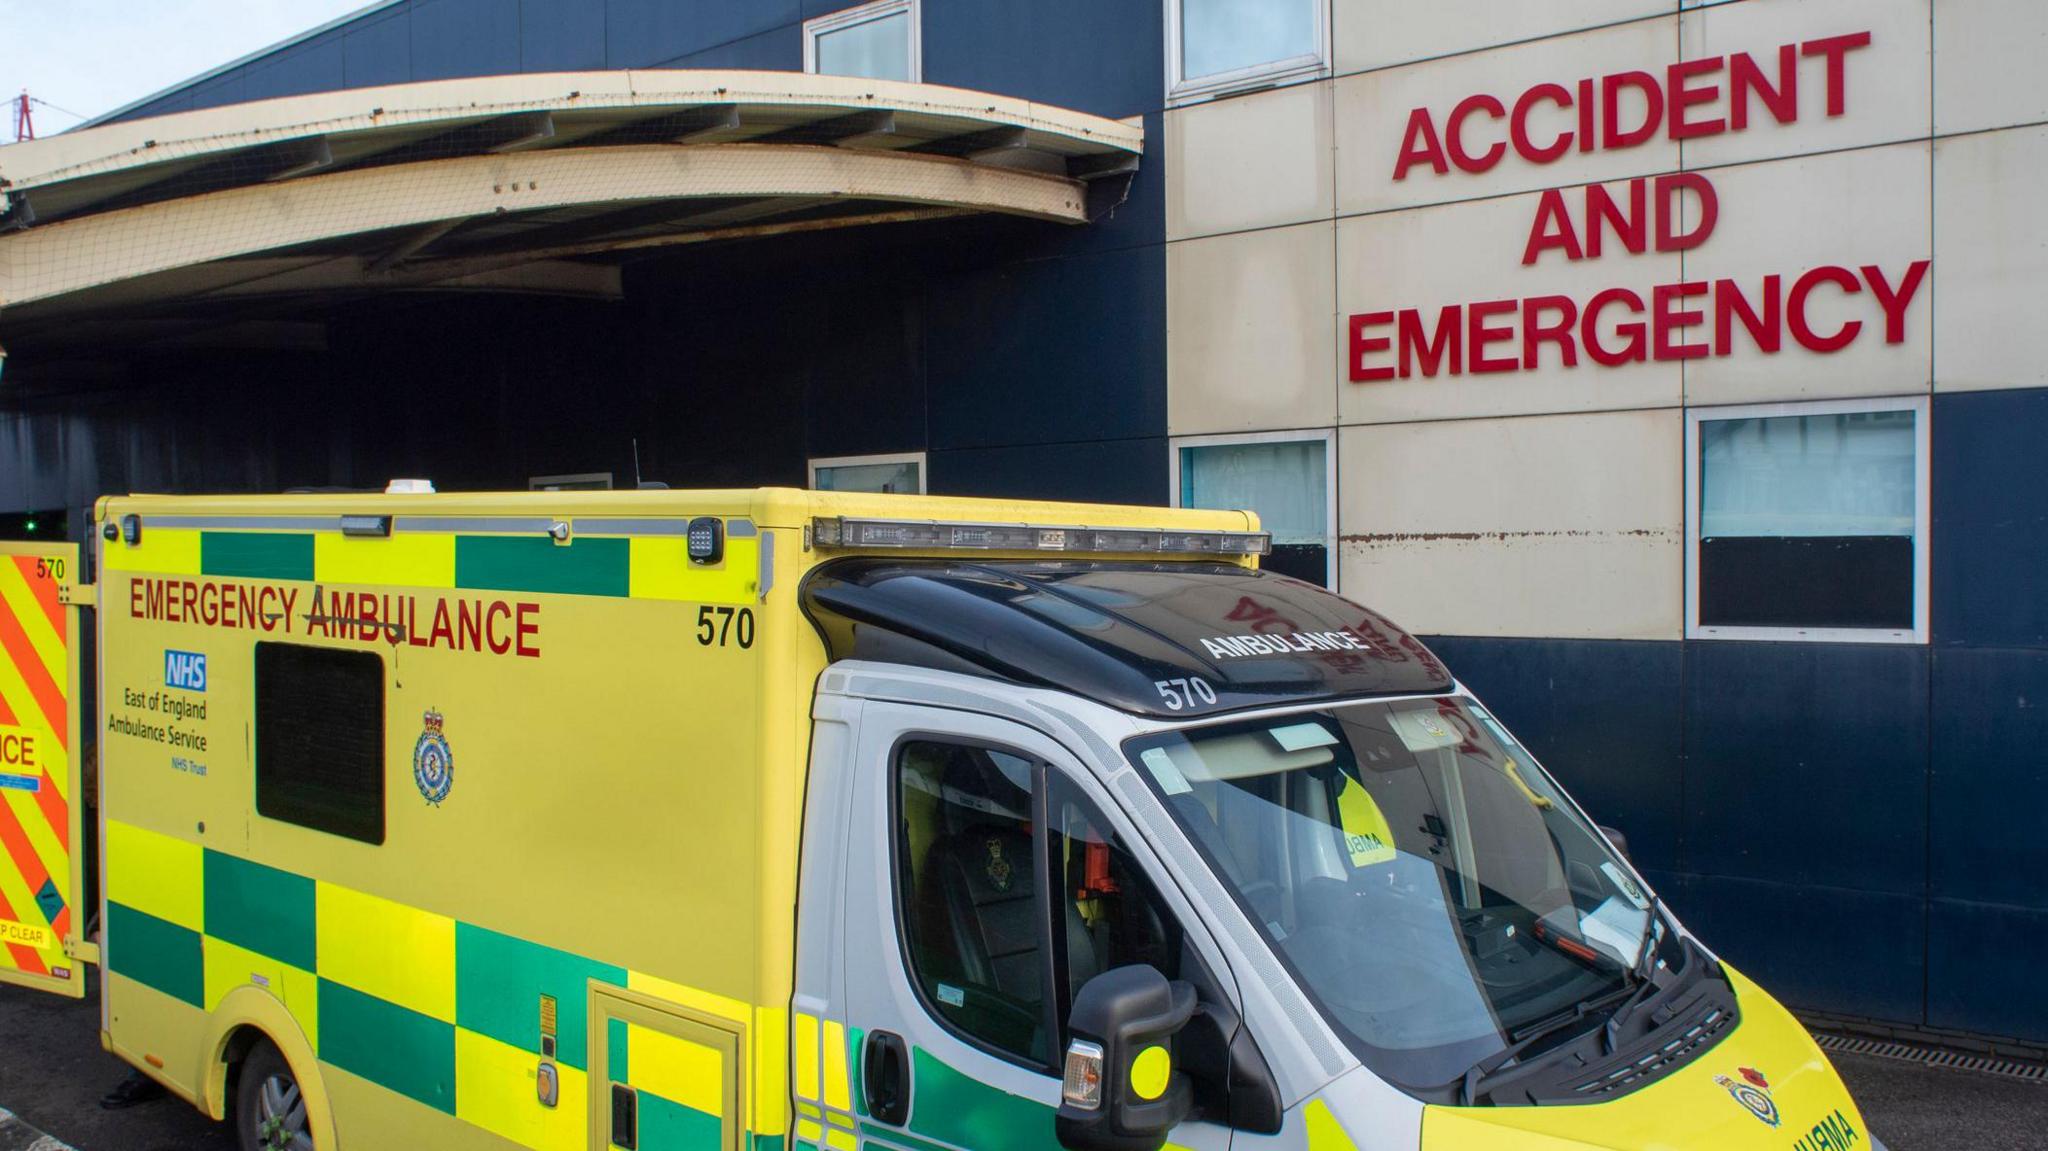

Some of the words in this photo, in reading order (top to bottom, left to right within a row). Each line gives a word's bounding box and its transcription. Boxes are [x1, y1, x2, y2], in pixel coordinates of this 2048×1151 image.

[1392, 31, 1871, 181] ACCIDENT
[1521, 172, 1719, 266] AND
[1348, 260, 1931, 383] EMERGENCY
[37, 558, 65, 578] 570
[131, 577, 298, 633] EMERGENCY
[307, 588, 541, 658] AMBULANCE
[697, 605, 754, 649] 570
[1200, 631, 1370, 659] AMBULANCE
[166, 653, 206, 689] NHS
[124, 687, 146, 708] East
[148, 691, 159, 711] of
[162, 694, 206, 721] England
[1154, 676, 1217, 711] 570
[0, 734, 35, 766] CE
[108, 713, 165, 743] Ambulance
[168, 725, 207, 752] Service
[171, 757, 187, 772] NHS
[189, 760, 207, 776] Trust
[10, 925, 44, 944] CLEAR
